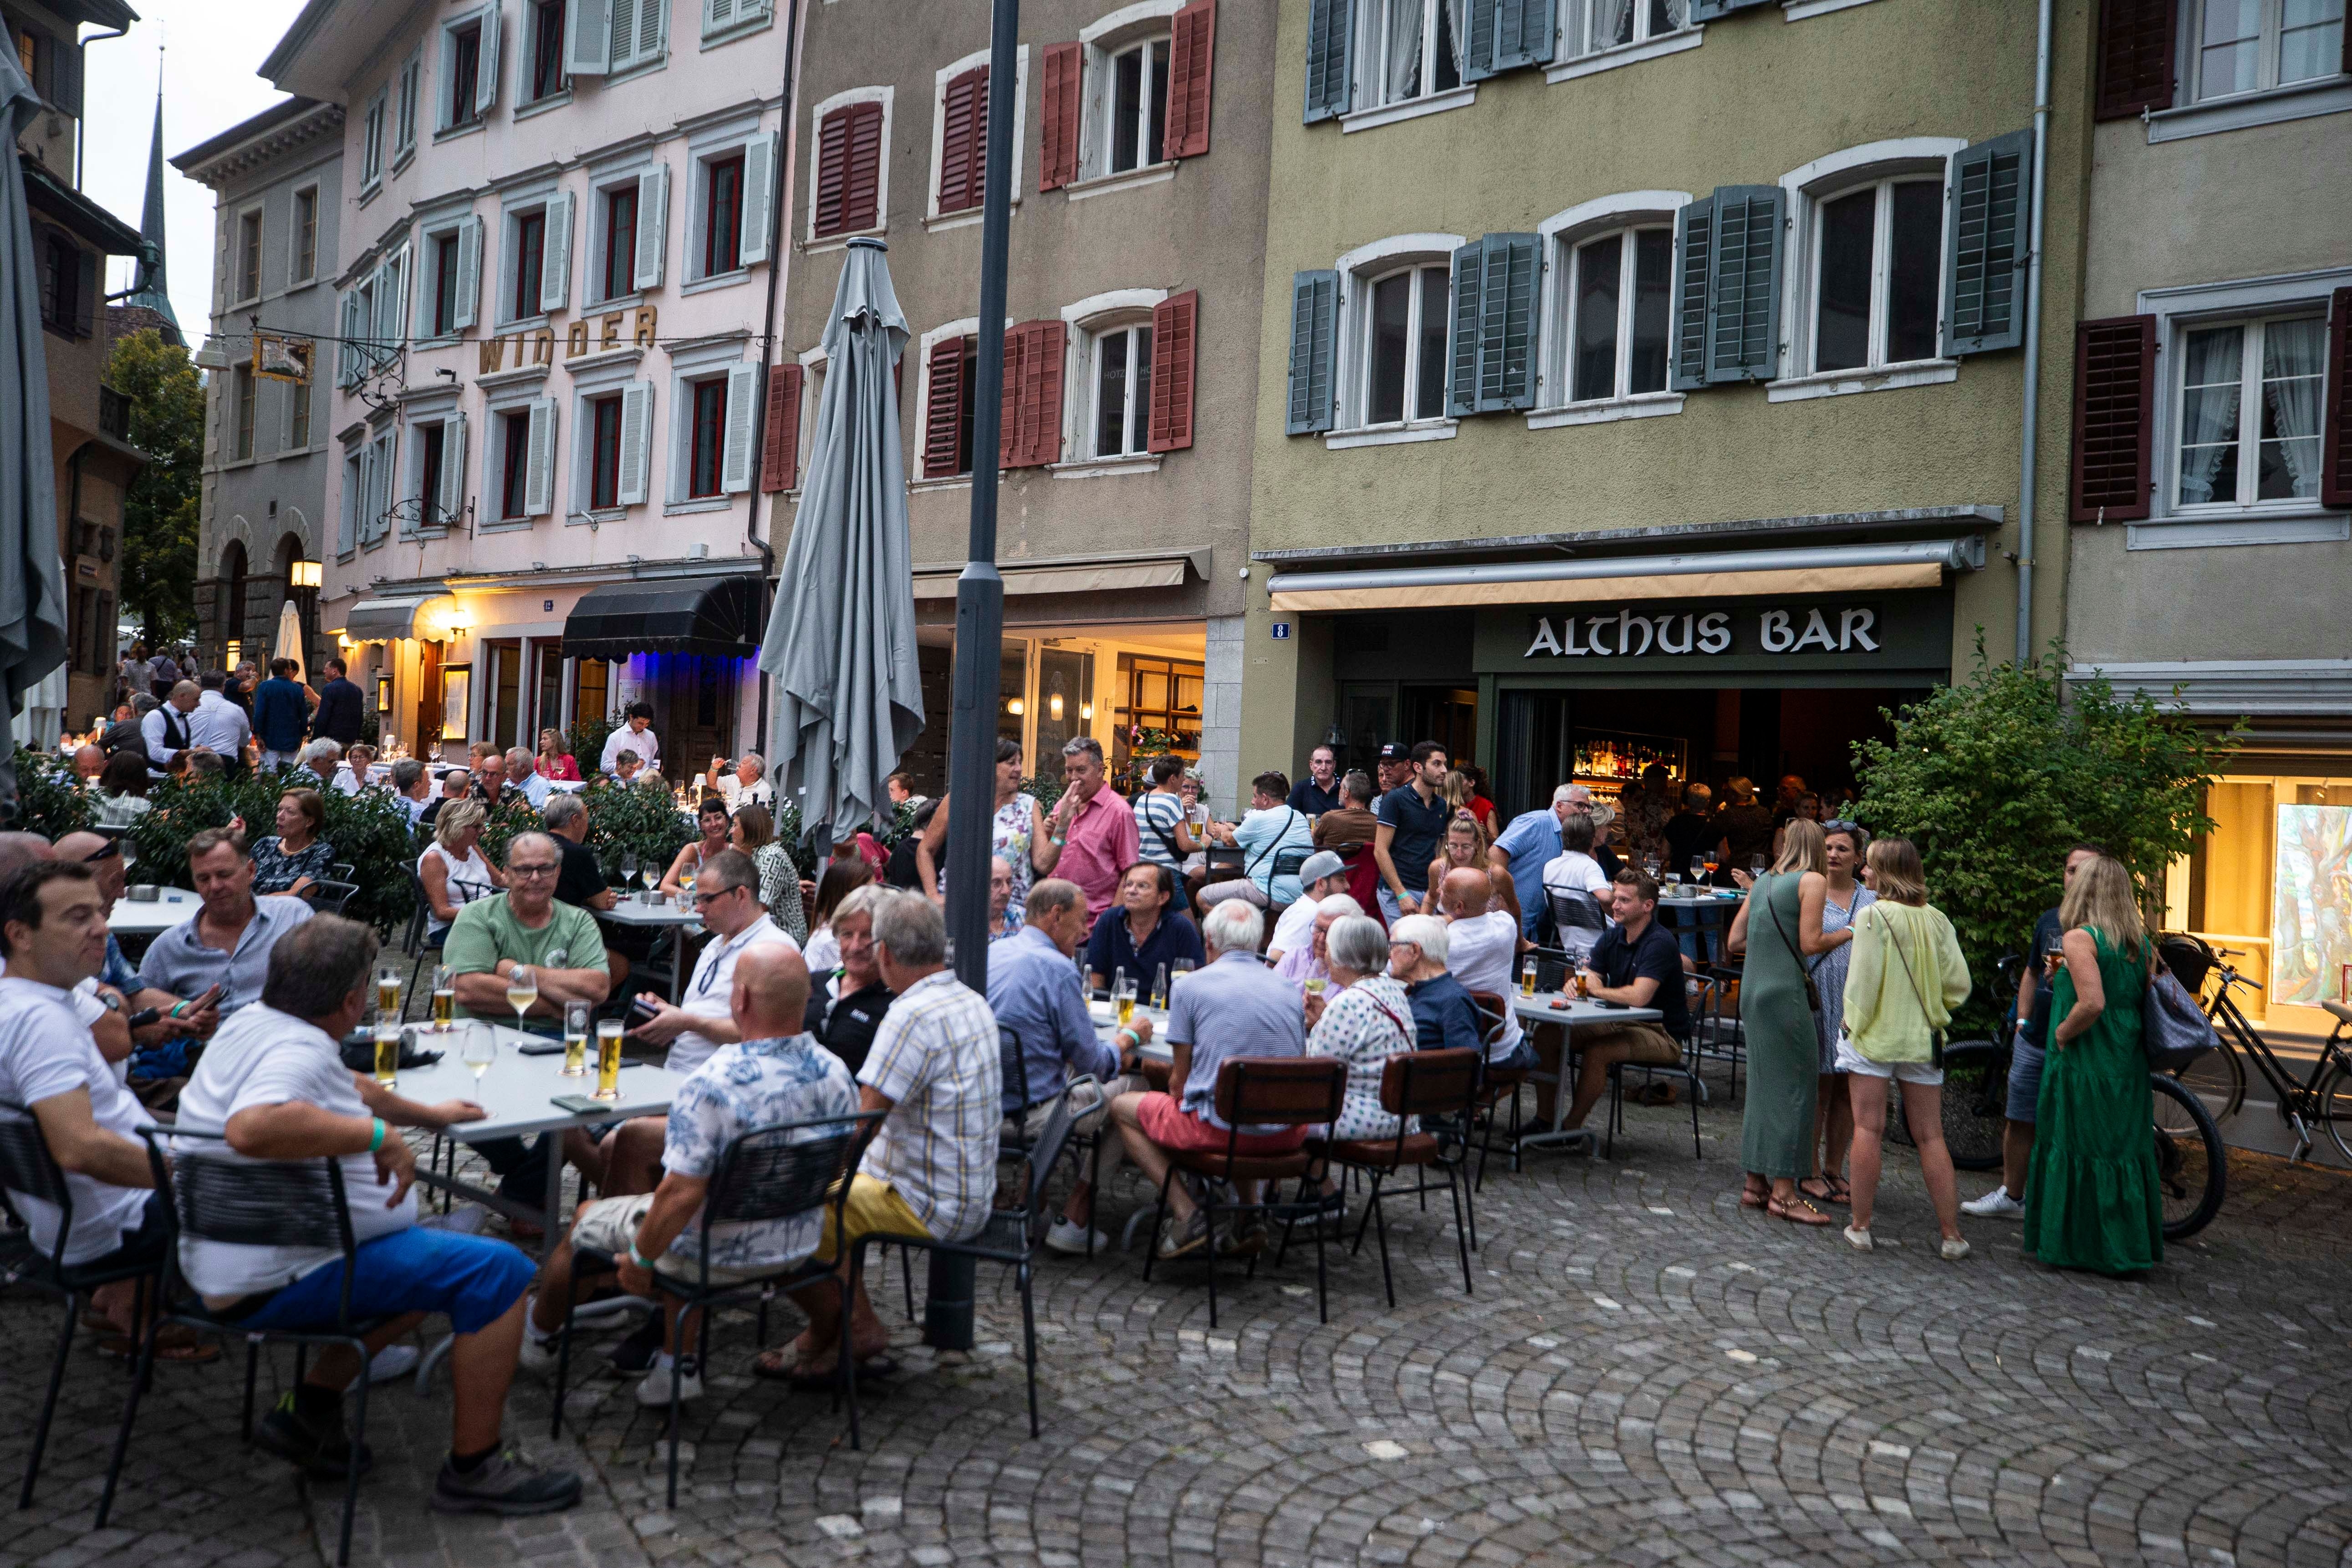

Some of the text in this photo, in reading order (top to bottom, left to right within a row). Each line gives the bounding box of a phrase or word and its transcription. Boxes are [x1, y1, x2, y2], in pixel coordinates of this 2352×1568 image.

[480, 305, 657, 375] WIDDER
[1104, 369, 1125, 379] HOTZ
[1277, 625, 1283, 637] 8
[1760, 608, 1880, 653] BAR
